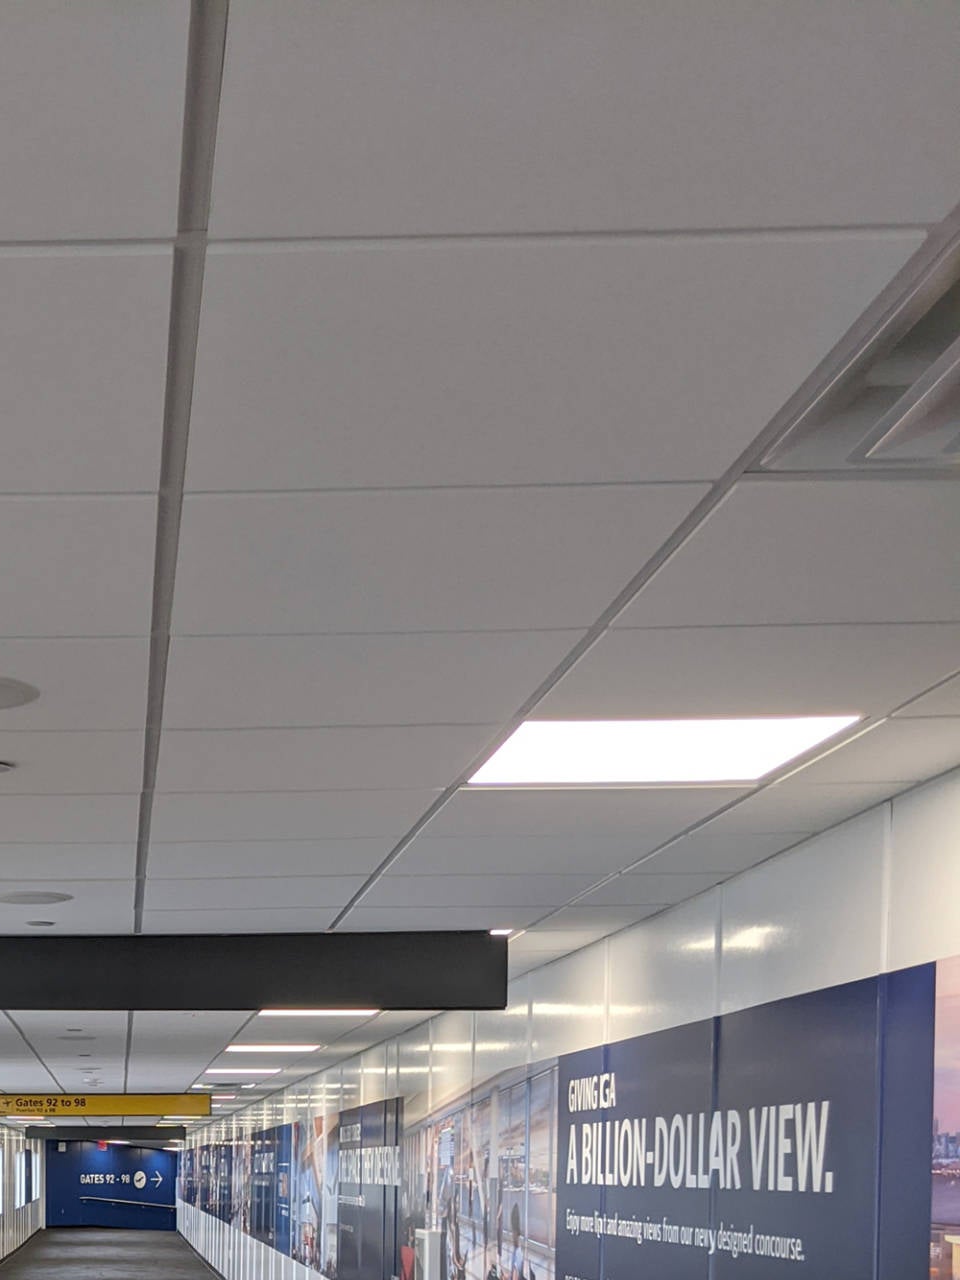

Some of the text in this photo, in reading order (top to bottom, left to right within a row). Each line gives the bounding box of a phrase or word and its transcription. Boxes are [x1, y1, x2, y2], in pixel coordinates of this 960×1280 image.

[16, 1098, 86, 1107] Gates 92 to 98
[568, 1075, 598, 1112] GIVING
[566, 1101, 833, 1193] A BILLION-DOLLAR VIEW.
[80, 1174, 105, 1184] GATES
[106, 1174, 115, 1184] 92
[121, 1174, 130, 1184] 98
[607, 1212, 617, 1236] and
[618, 1215, 642, 1245] amazing
[643, 1216, 661, 1242] views
[663, 1217, 679, 1243] from
[680, 1226, 693, 1245] our
[694, 1227, 716, 1255] newy
[717, 1221, 753, 1258] designed
[754, 1234, 805, 1260] concourse.
